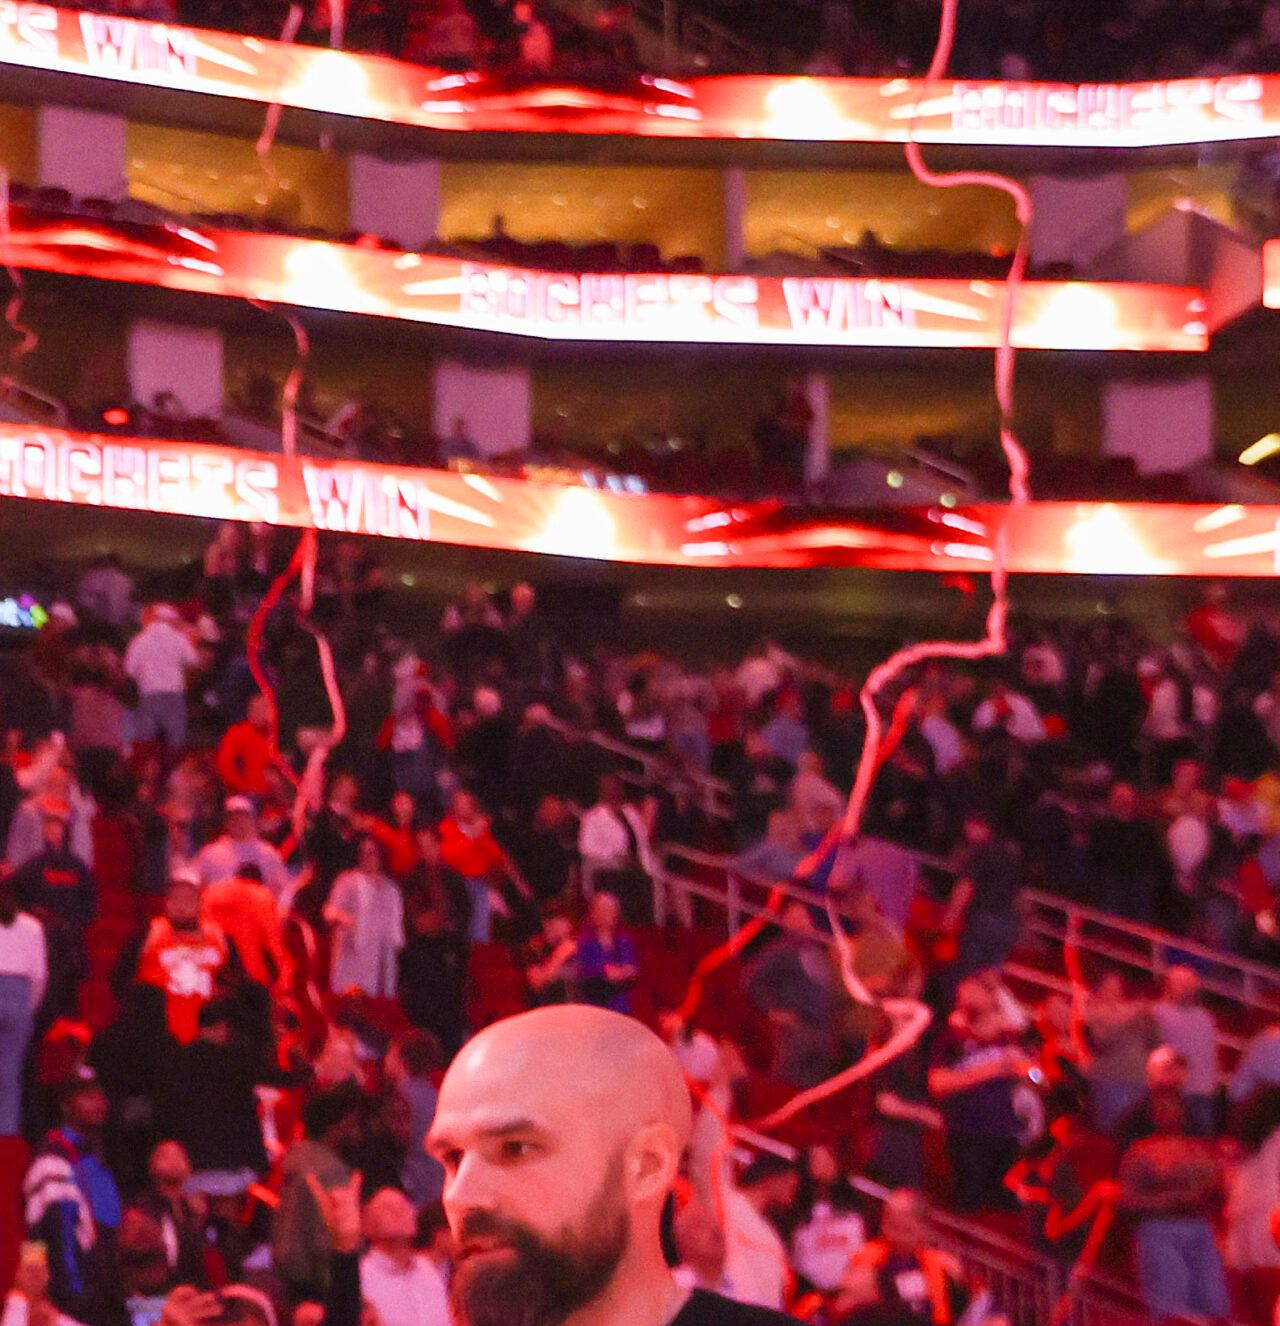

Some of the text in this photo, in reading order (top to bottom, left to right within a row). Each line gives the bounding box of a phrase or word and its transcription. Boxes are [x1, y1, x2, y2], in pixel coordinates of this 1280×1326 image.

[79, 12, 197, 76] WIN
[782, 278, 916, 331] WIN
[302, 460, 431, 540] WIN
